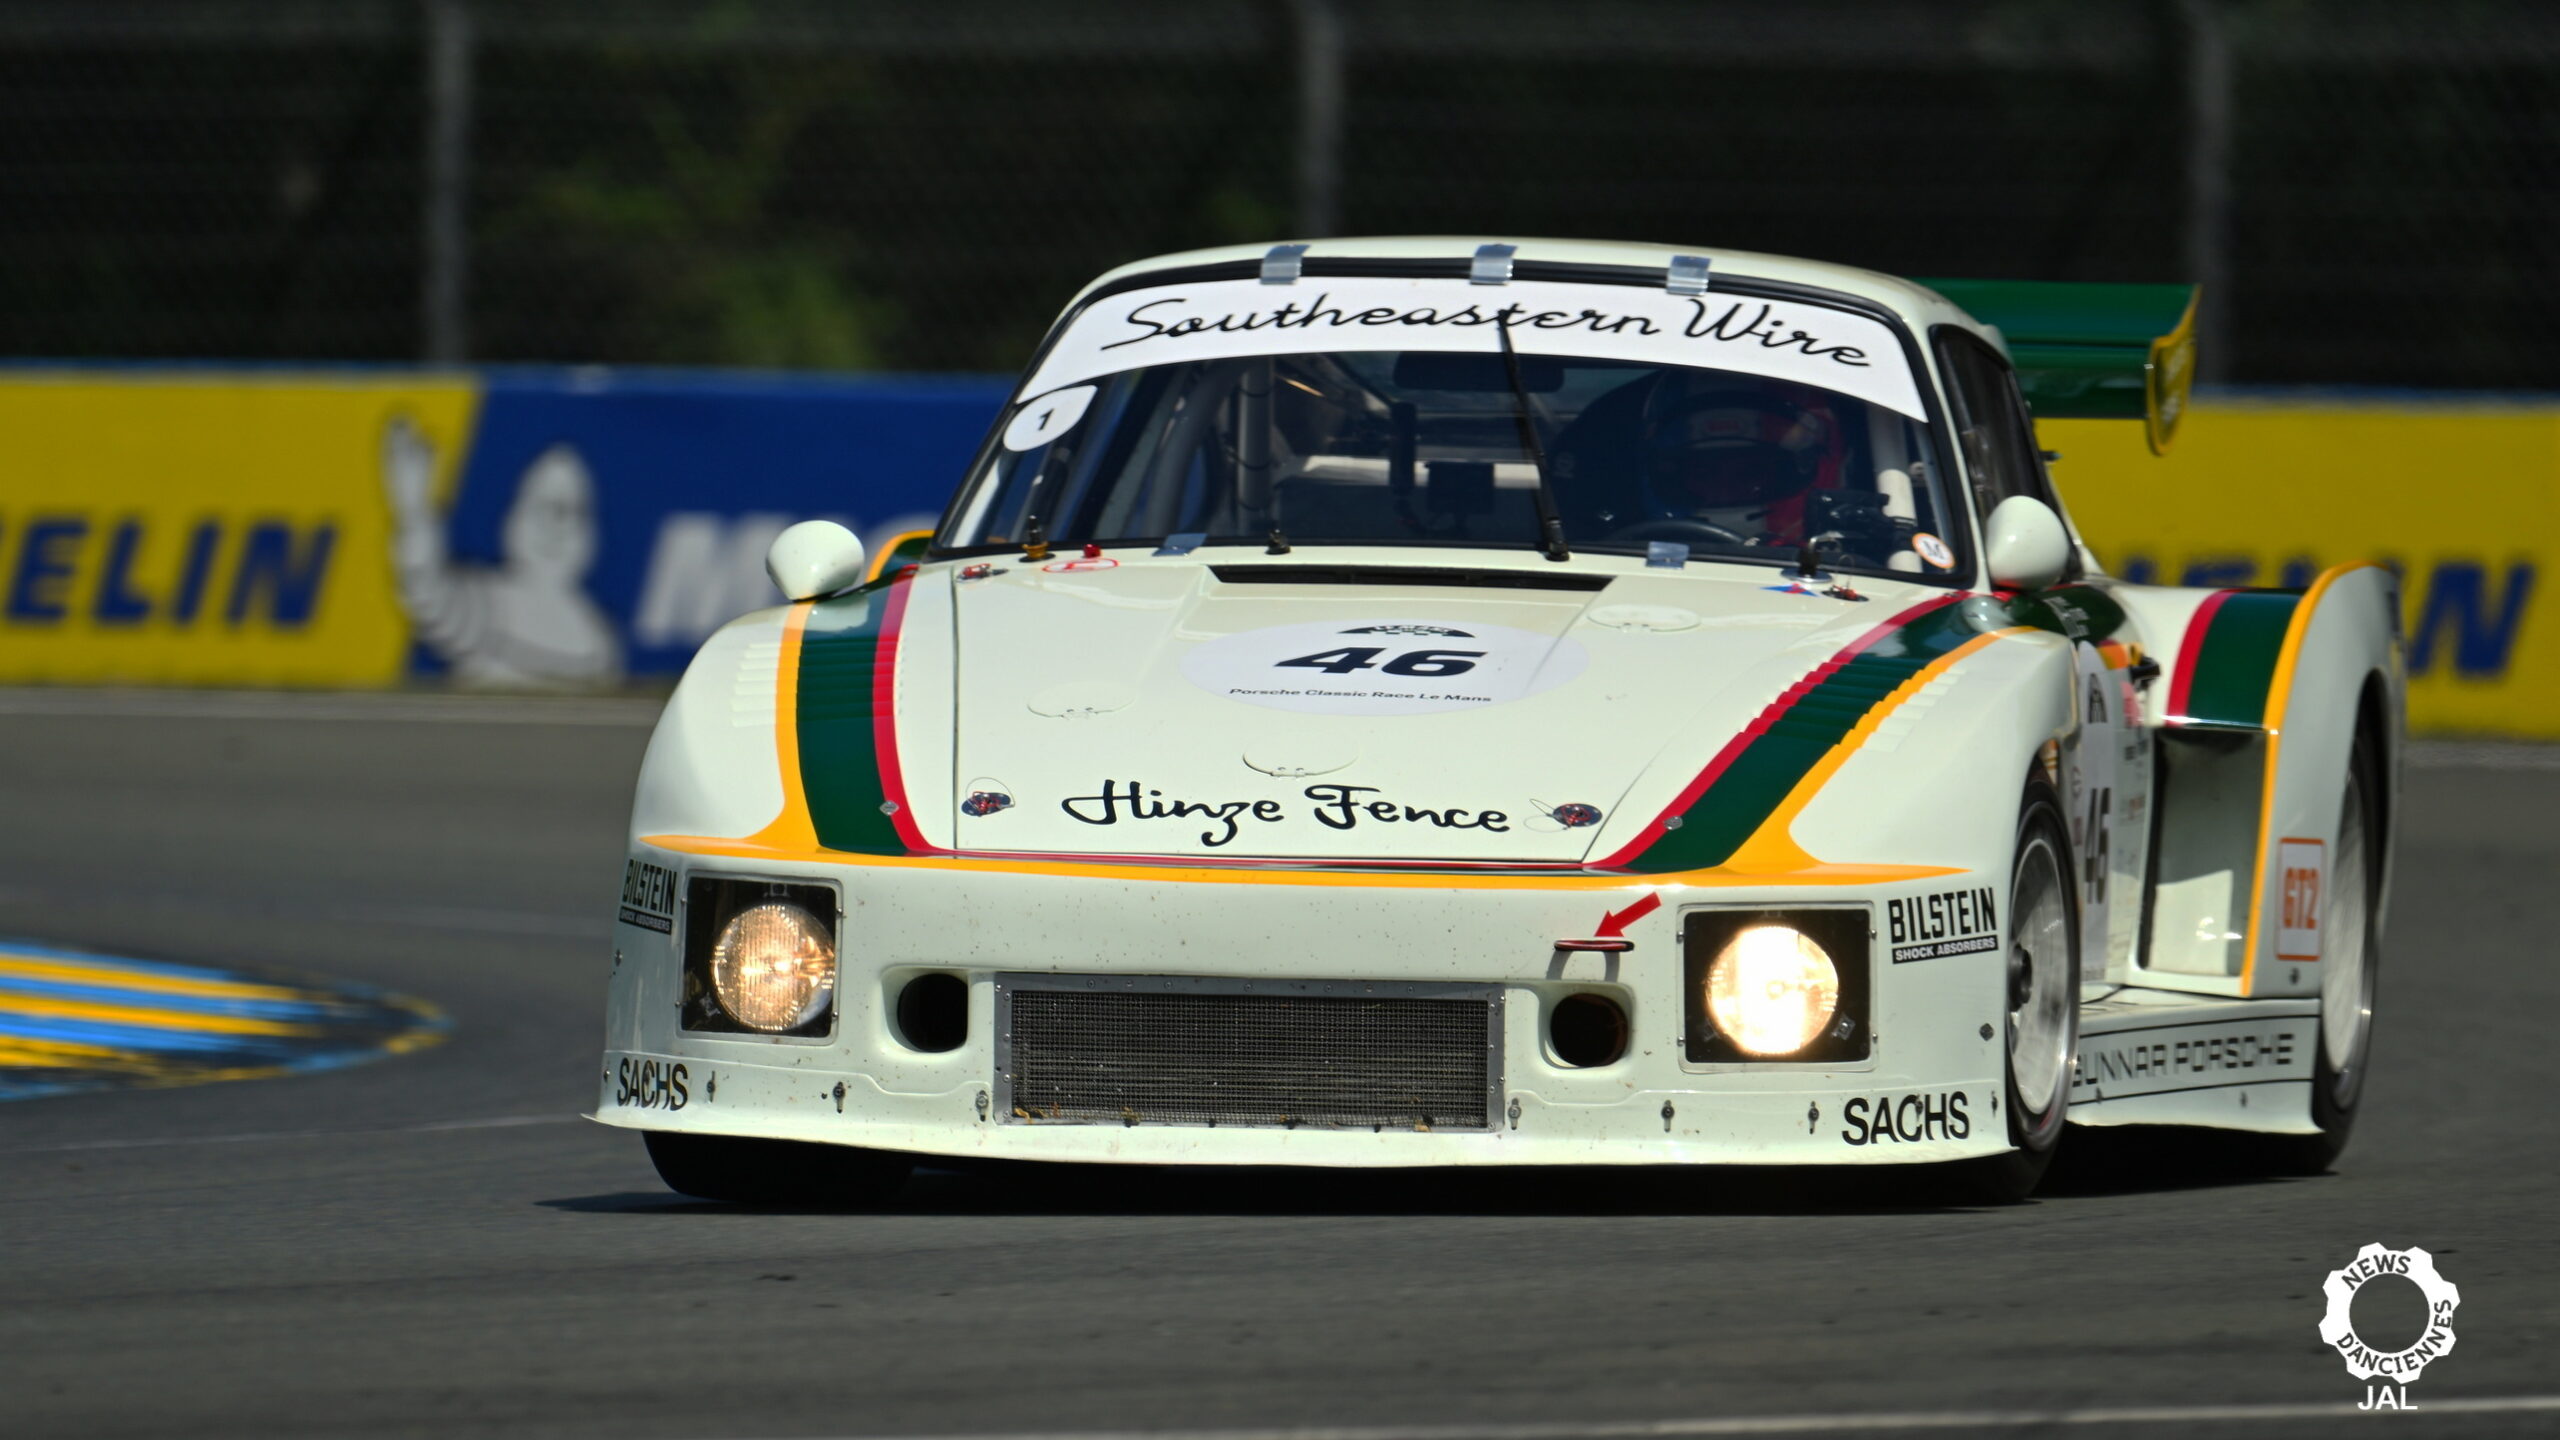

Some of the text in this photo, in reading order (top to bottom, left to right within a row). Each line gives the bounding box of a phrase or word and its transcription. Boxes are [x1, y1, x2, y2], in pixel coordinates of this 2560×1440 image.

[1101, 293, 1871, 367] Southeastern Wire
[1038, 407, 1054, 431] 1
[0, 513, 340, 630] ELIN
[1274, 646, 1488, 677] 46
[1229, 688, 1301, 696] Porsche
[1305, 689, 1368, 697] Classic
[1372, 691, 1415, 699] Race
[1444, 694, 1492, 702] Mans
[1061, 779, 1510, 847] Hinze Fence
[622, 858, 677, 916] BILSTEIN
[1887, 886, 1997, 944] BILSTEIN
[1895, 937, 1996, 961] SHOCK ABSORBERS
[2172, 1033, 2295, 1074] PORSCHE
[616, 1057, 689, 1111] SACHS
[1841, 1091, 1970, 1146] SACHS
